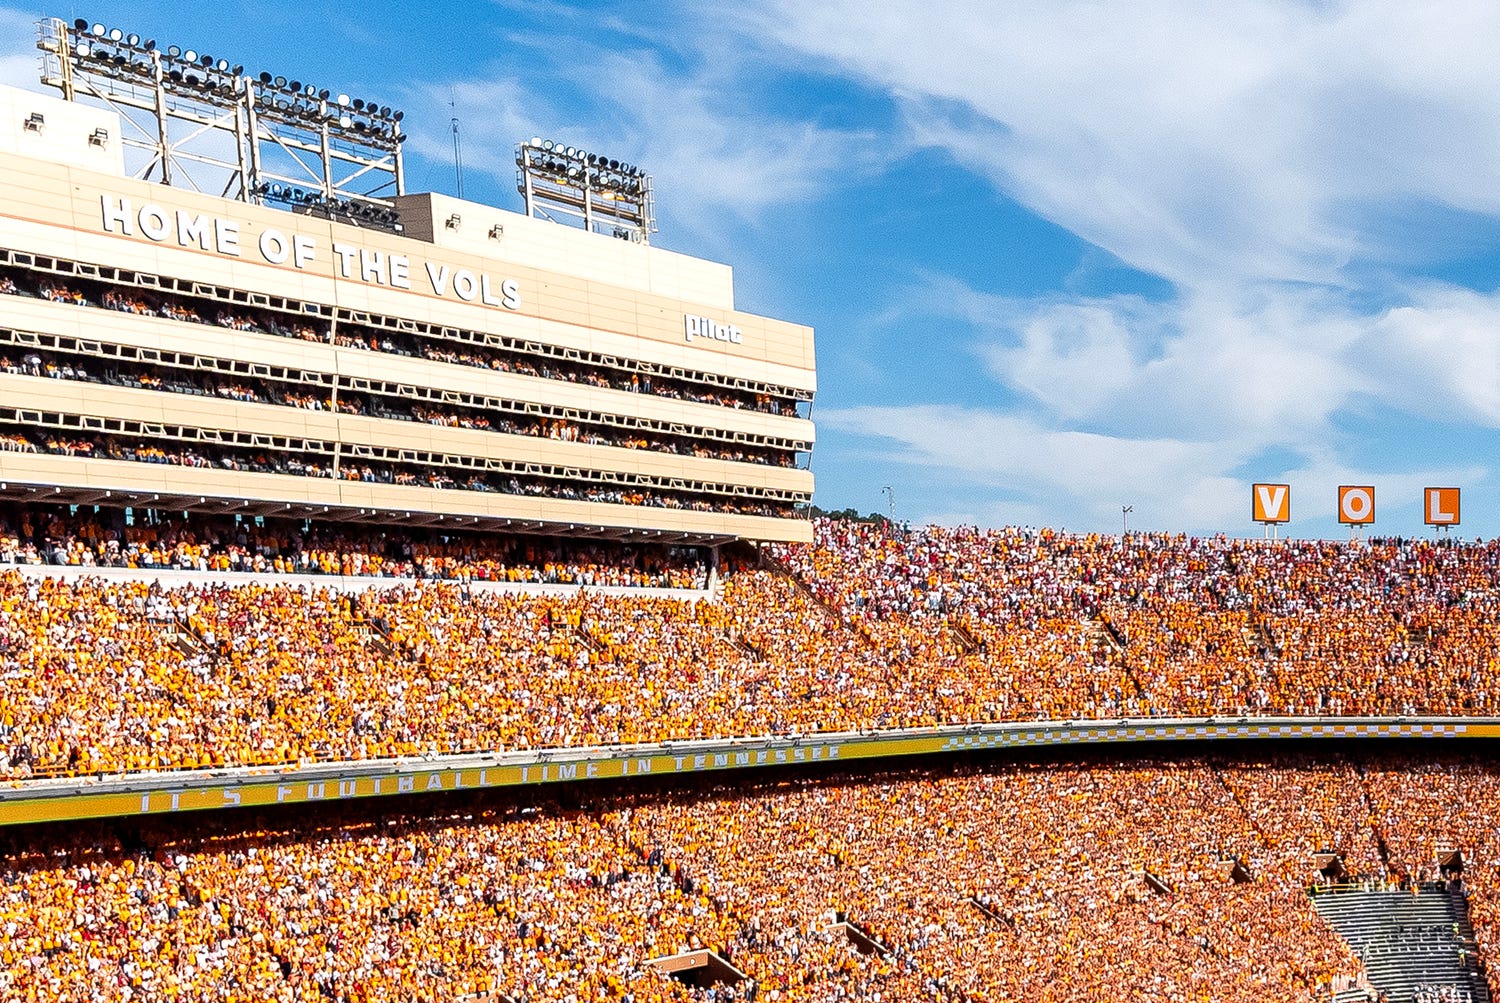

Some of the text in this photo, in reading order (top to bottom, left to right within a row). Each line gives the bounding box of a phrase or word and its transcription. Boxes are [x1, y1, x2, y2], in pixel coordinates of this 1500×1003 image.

[101, 194, 522, 310] HOME OF THE VOLS
[277, 768, 491, 803] FOOTBALL
[520, 760, 599, 784] TIME
[622, 757, 651, 775] IN
[673, 746, 839, 772] TENNESSEE
